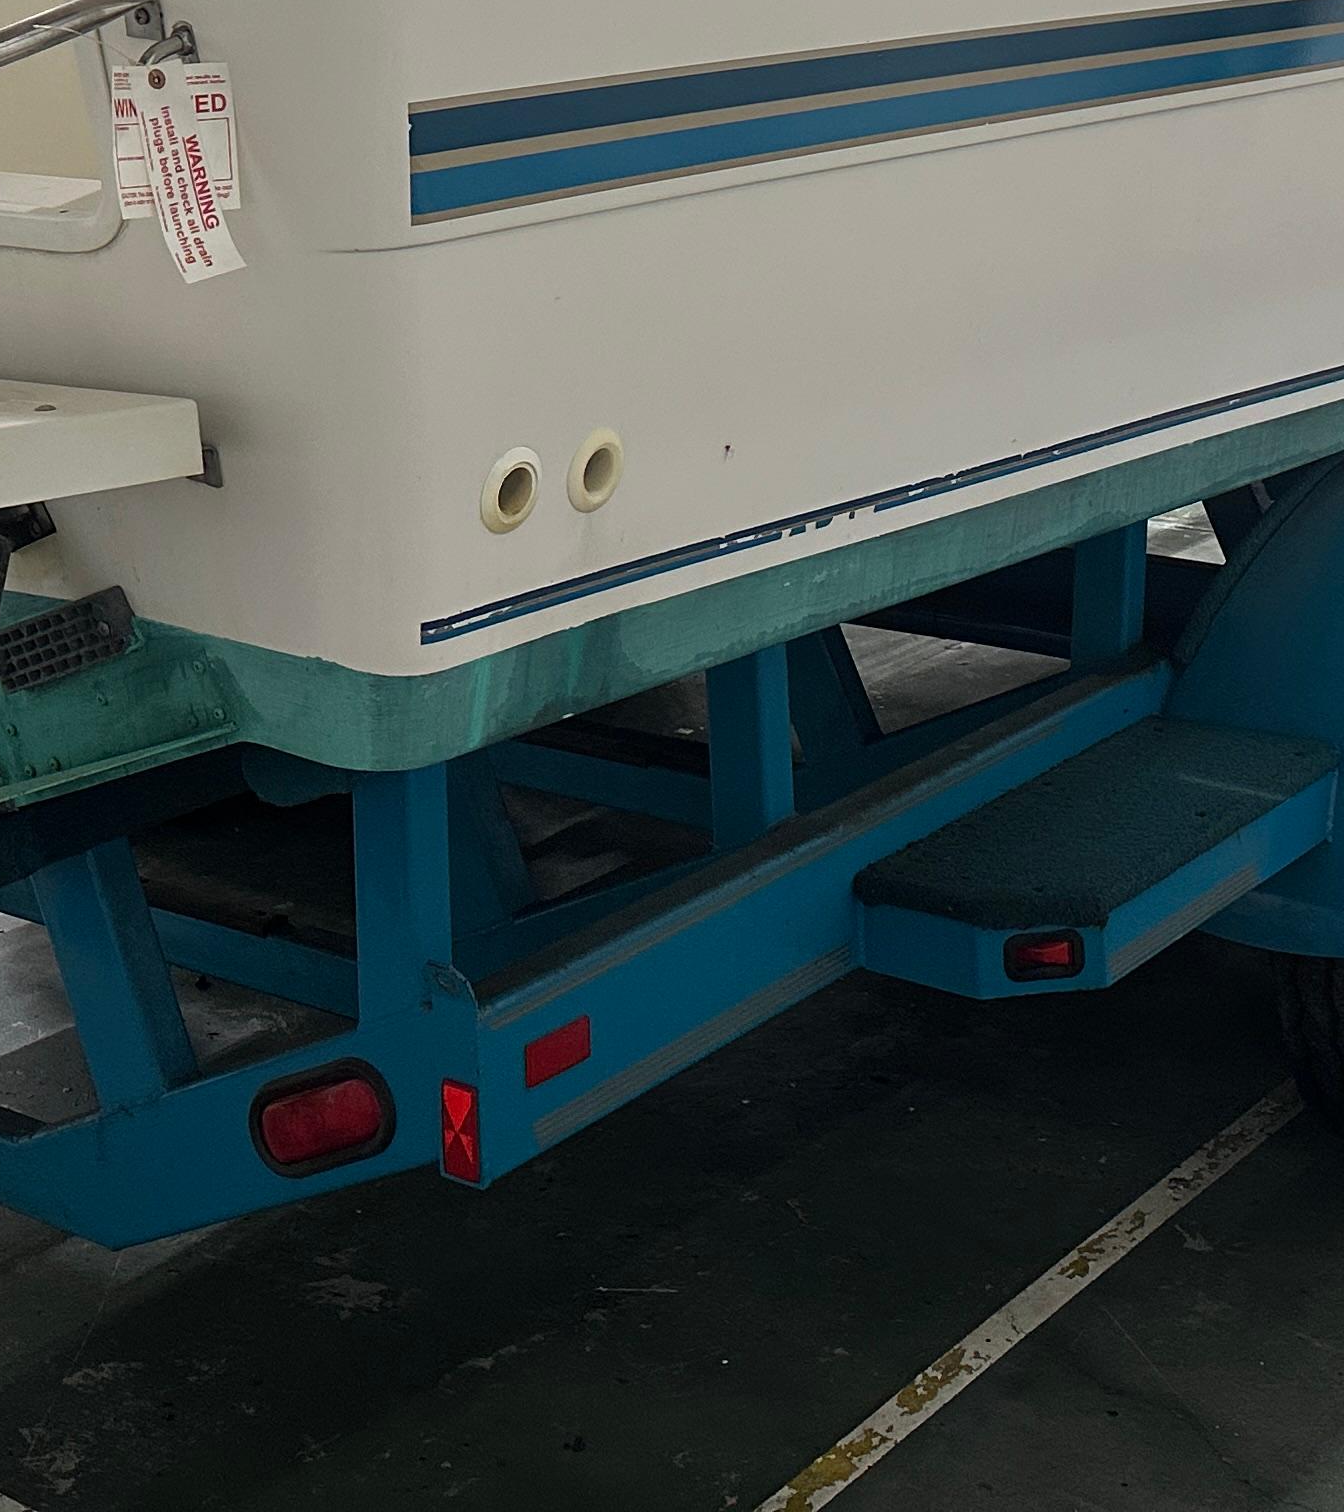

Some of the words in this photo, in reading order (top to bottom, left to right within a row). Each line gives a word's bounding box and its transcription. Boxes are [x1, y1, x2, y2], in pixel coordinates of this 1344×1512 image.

[160, 105, 179, 146] Install
[171, 151, 186, 173] and
[185, 134, 220, 230] WARNING
[149, 117, 165, 154] plugs
[159, 157, 175, 200] before
[168, 202, 197, 265] launching
[177, 174, 194, 216] check
[187, 220, 201, 235] all
[193, 236, 214, 268] drain
